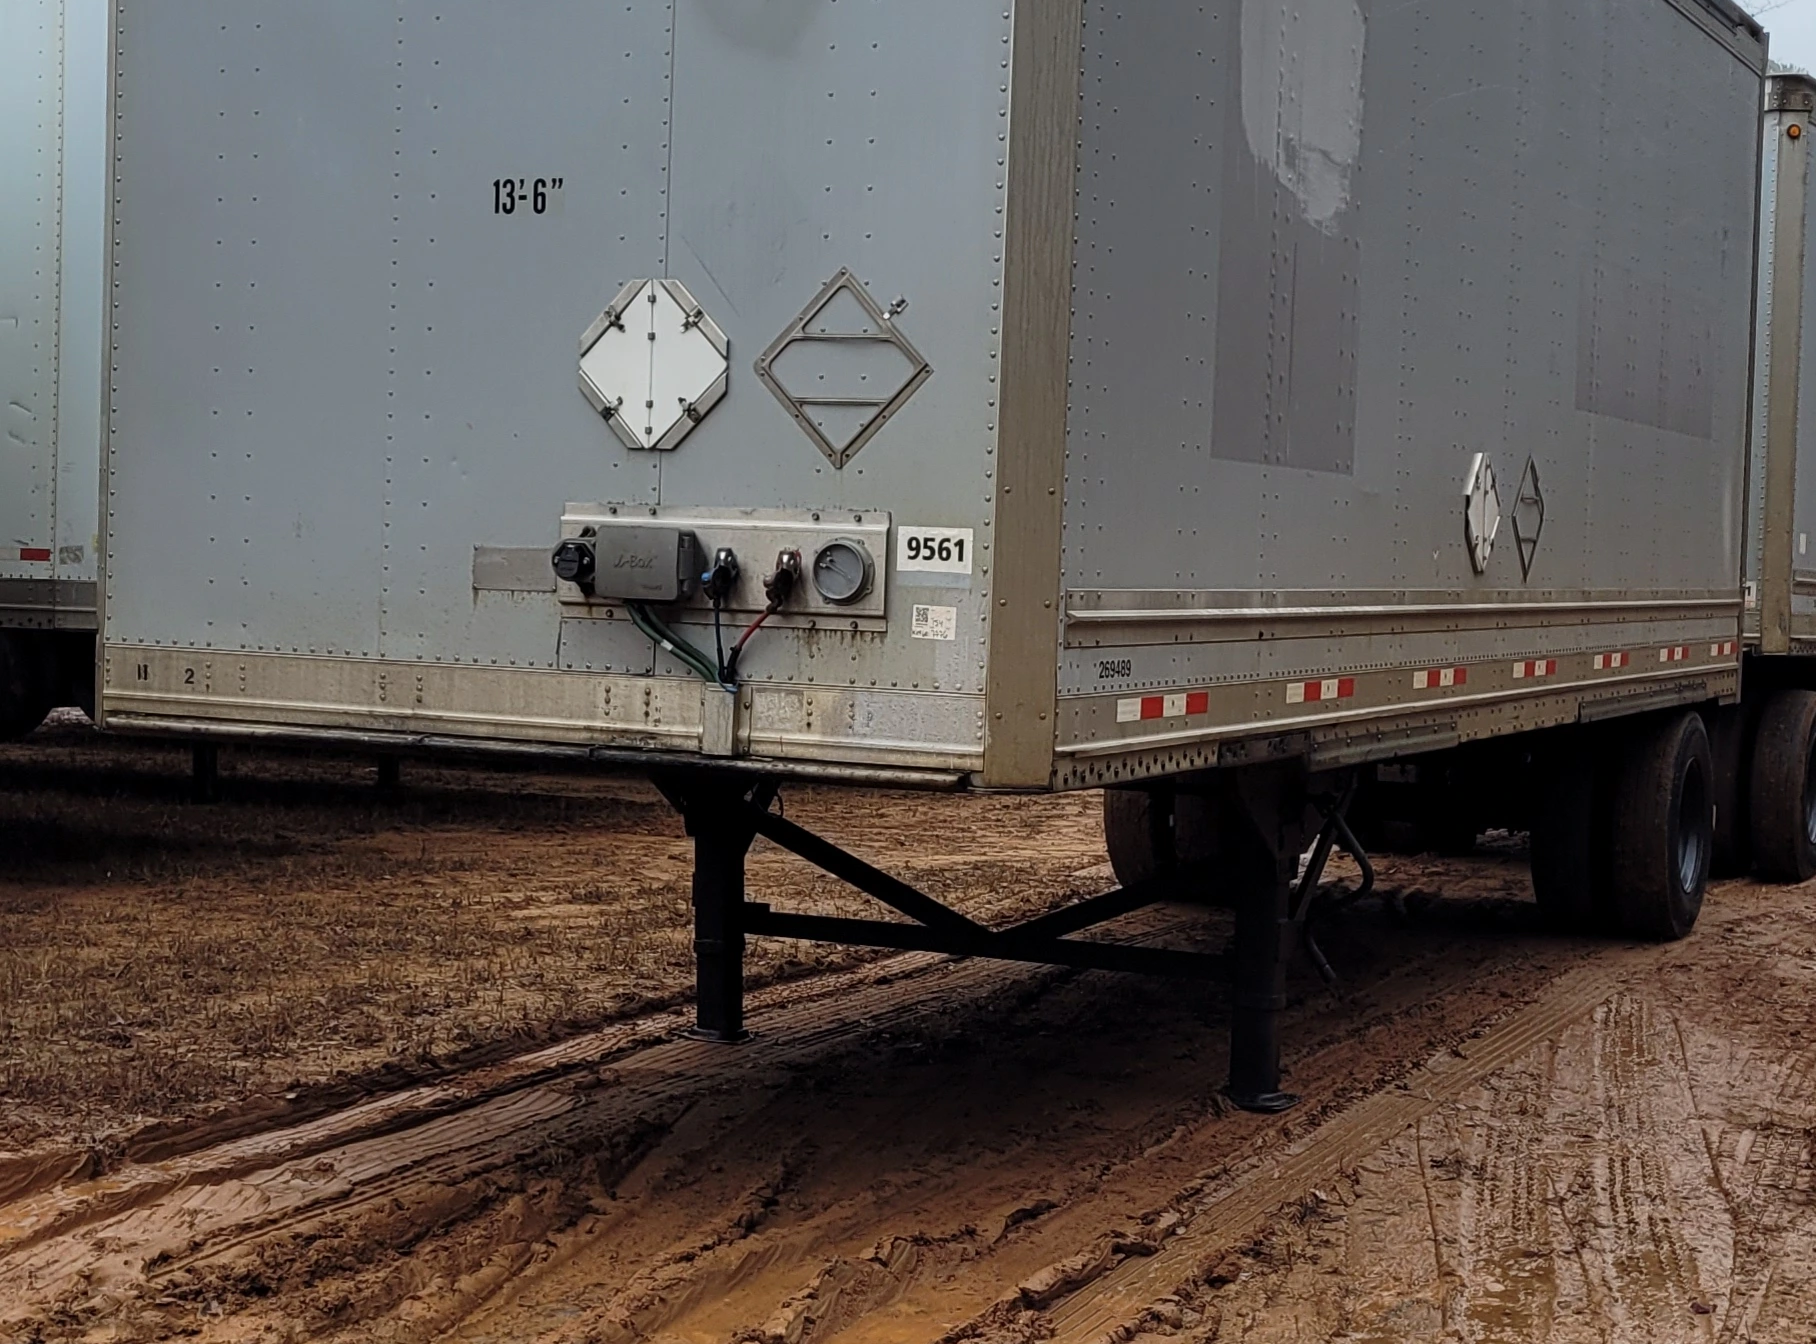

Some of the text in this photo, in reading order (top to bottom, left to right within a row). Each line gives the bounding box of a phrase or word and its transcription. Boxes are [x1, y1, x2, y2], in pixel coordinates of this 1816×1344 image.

[907, 536, 964, 563] 9561
[184, 668, 194, 684] 2
[1098, 659, 1131, 679] 269489
